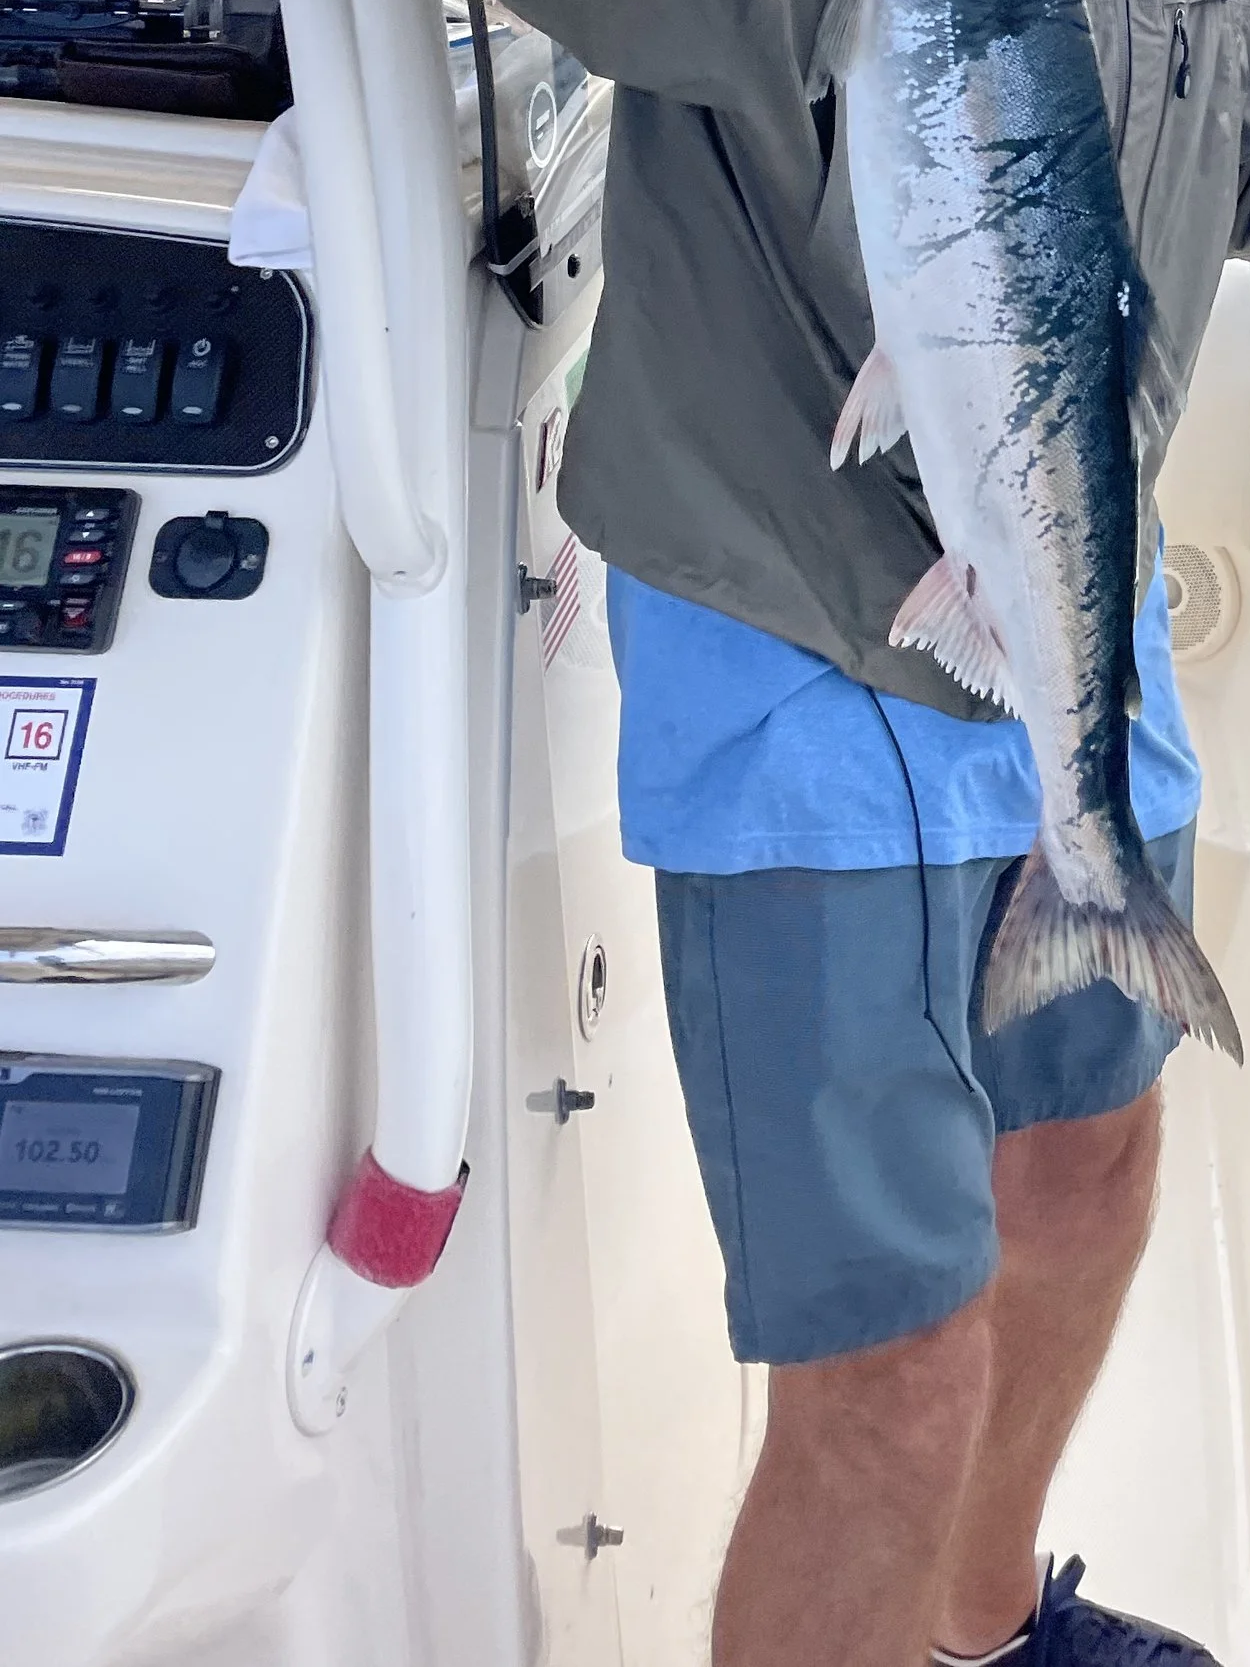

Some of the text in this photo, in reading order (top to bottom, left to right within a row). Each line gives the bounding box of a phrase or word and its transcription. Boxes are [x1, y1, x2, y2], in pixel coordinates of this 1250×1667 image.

[0, 691, 56, 701] OCEDURES
[20, 721, 53, 750] 16
[12, 762, 48, 771] VHF-FM
[15, 1138, 100, 1164] 102.50
